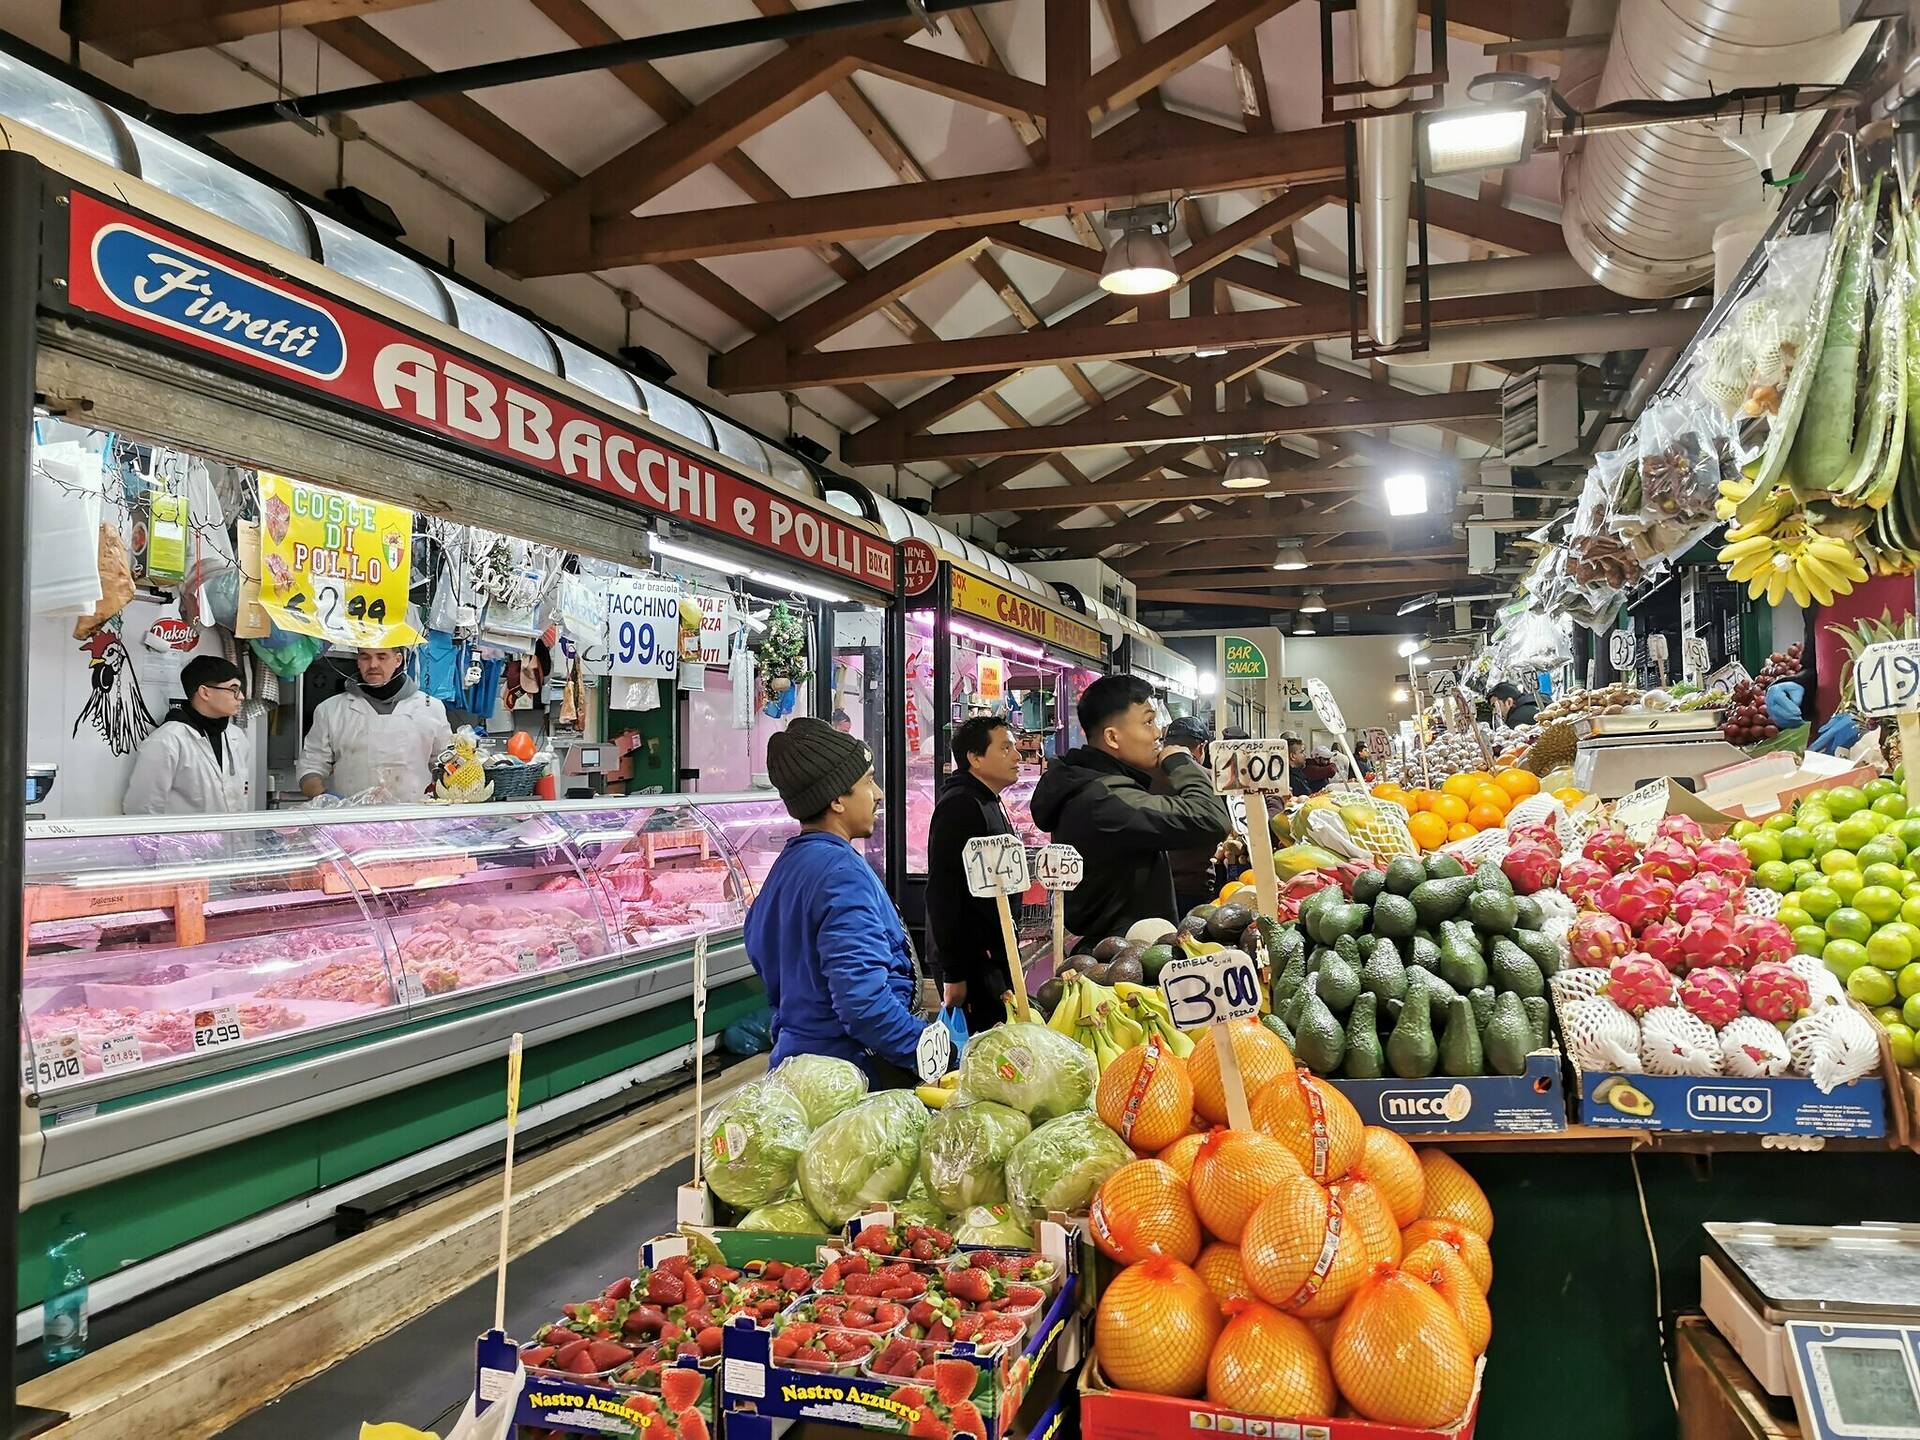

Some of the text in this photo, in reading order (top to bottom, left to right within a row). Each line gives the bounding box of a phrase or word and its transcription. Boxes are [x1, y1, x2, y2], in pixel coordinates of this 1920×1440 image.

[134, 253, 320, 359] Fioretti
[373, 344, 889, 575] ABBACCHI e POLLI BOX 4
[293, 488, 377, 531] COSCE
[325, 524, 355, 553] DI
[294, 542, 382, 584] POLLO
[904, 547, 926, 559] ARNE
[647, 582, 679, 594] braciola
[904, 575, 923, 588] OX 3
[606, 593, 677, 618] TACCHINO
[996, 594, 1047, 635] CARNI
[701, 617, 721, 631] RZA
[1227, 646, 1252, 660] BAR
[1227, 661, 1261, 674] SNACK
[1619, 780, 1666, 808] DRAGON
[971, 837, 1010, 851] BANANA
[1171, 956, 1214, 973] POMELO
[1388, 1098, 1446, 1115] nico
[1697, 1094, 1763, 1114] nico
[529, 1392, 584, 1408] Nastro
[585, 1394, 652, 1428] Azzurro
[781, 1385, 844, 1402] Nastro
[845, 1386, 921, 1422] Azzurro
